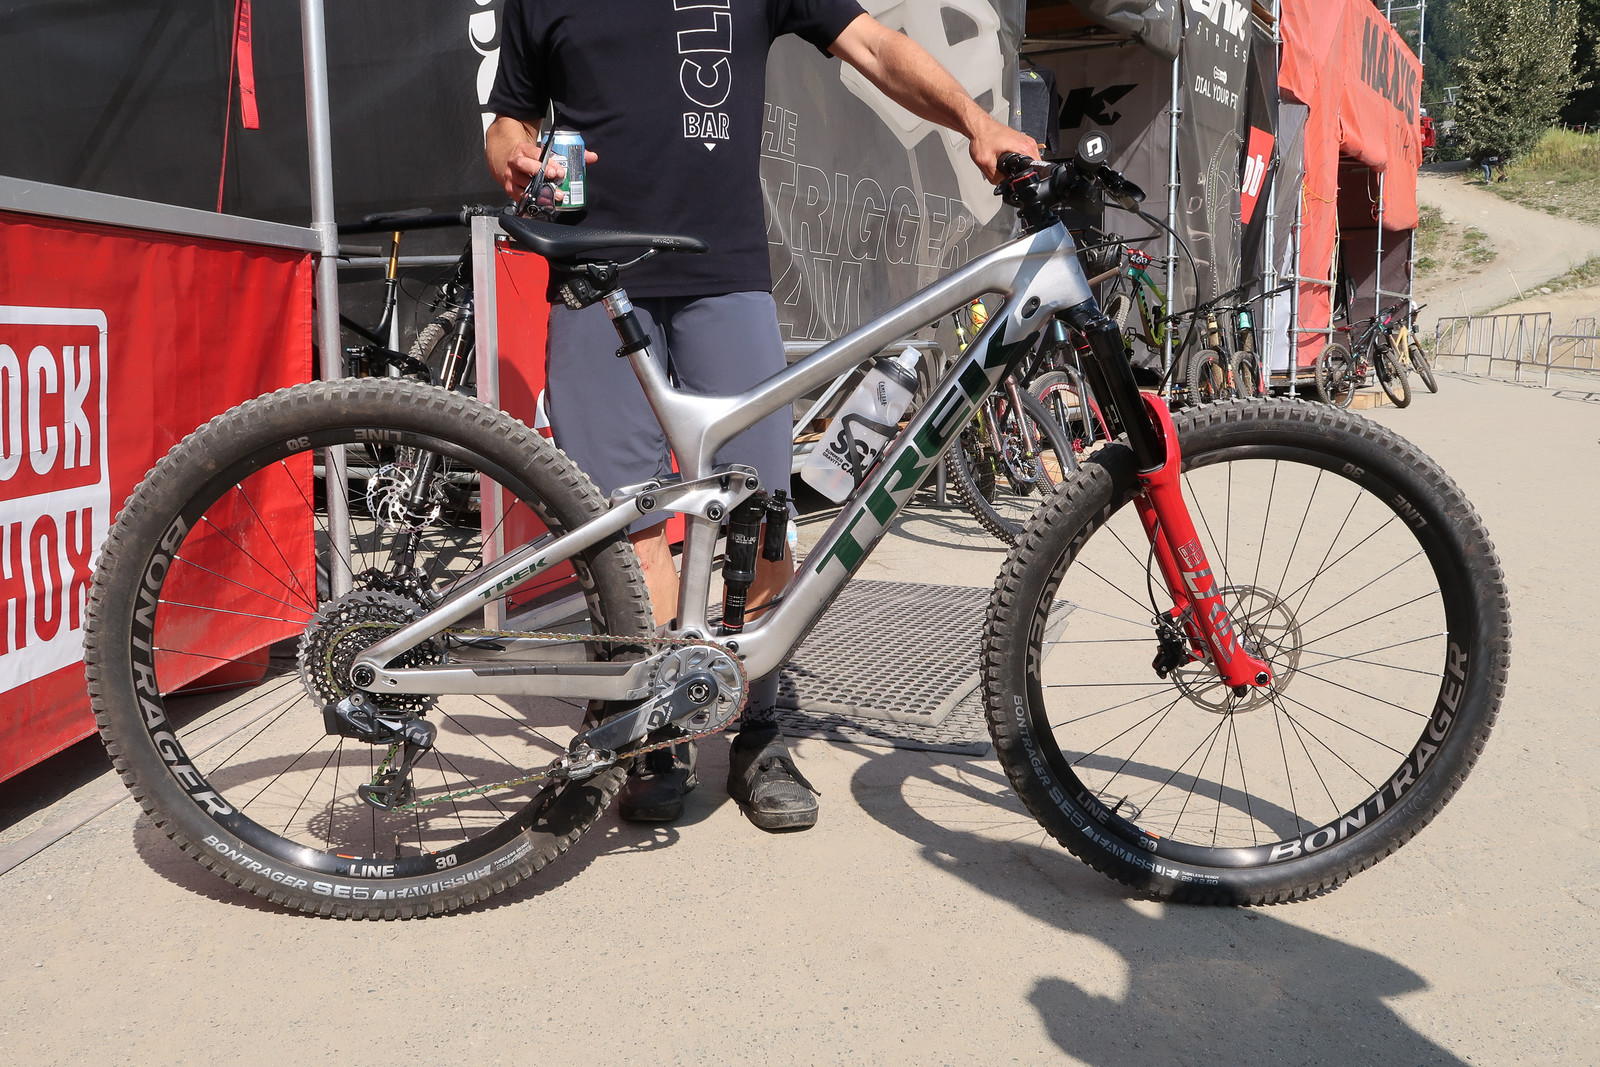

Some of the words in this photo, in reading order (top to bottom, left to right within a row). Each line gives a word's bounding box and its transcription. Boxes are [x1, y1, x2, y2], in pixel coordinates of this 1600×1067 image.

[673, 0, 732, 108] CL
[1195, 75, 1211, 98] DIAL
[1213, 83, 1229, 106] YOUR
[683, 112, 730, 140] BAR
[760, 154, 975, 270] TRIGGER
[286, 436, 312, 451] 30
[354, 429, 402, 443] LINE
[815, 314, 1023, 575] TREK
[822, 452, 842, 468] GRAVITY
[825, 448, 844, 464] SUMMER
[1342, 462, 1365, 479] 30
[1391, 494, 1428, 529] LINE
[478, 556, 548, 599] TREK
[133, 515, 233, 816] BONTRAGER
[1013, 694, 1051, 787] BONTRAGER
[1049, 785, 1085, 828] SE5
[1267, 642, 1470, 864] BONTRAGER
[1076, 791, 1110, 825] LINE
[1138, 836, 1159, 852] 30
[202, 834, 309, 890] BONTRAGER
[311, 880, 370, 900] SE5
[350, 864, 396, 878] LINE
[435, 853, 458, 870] 30
